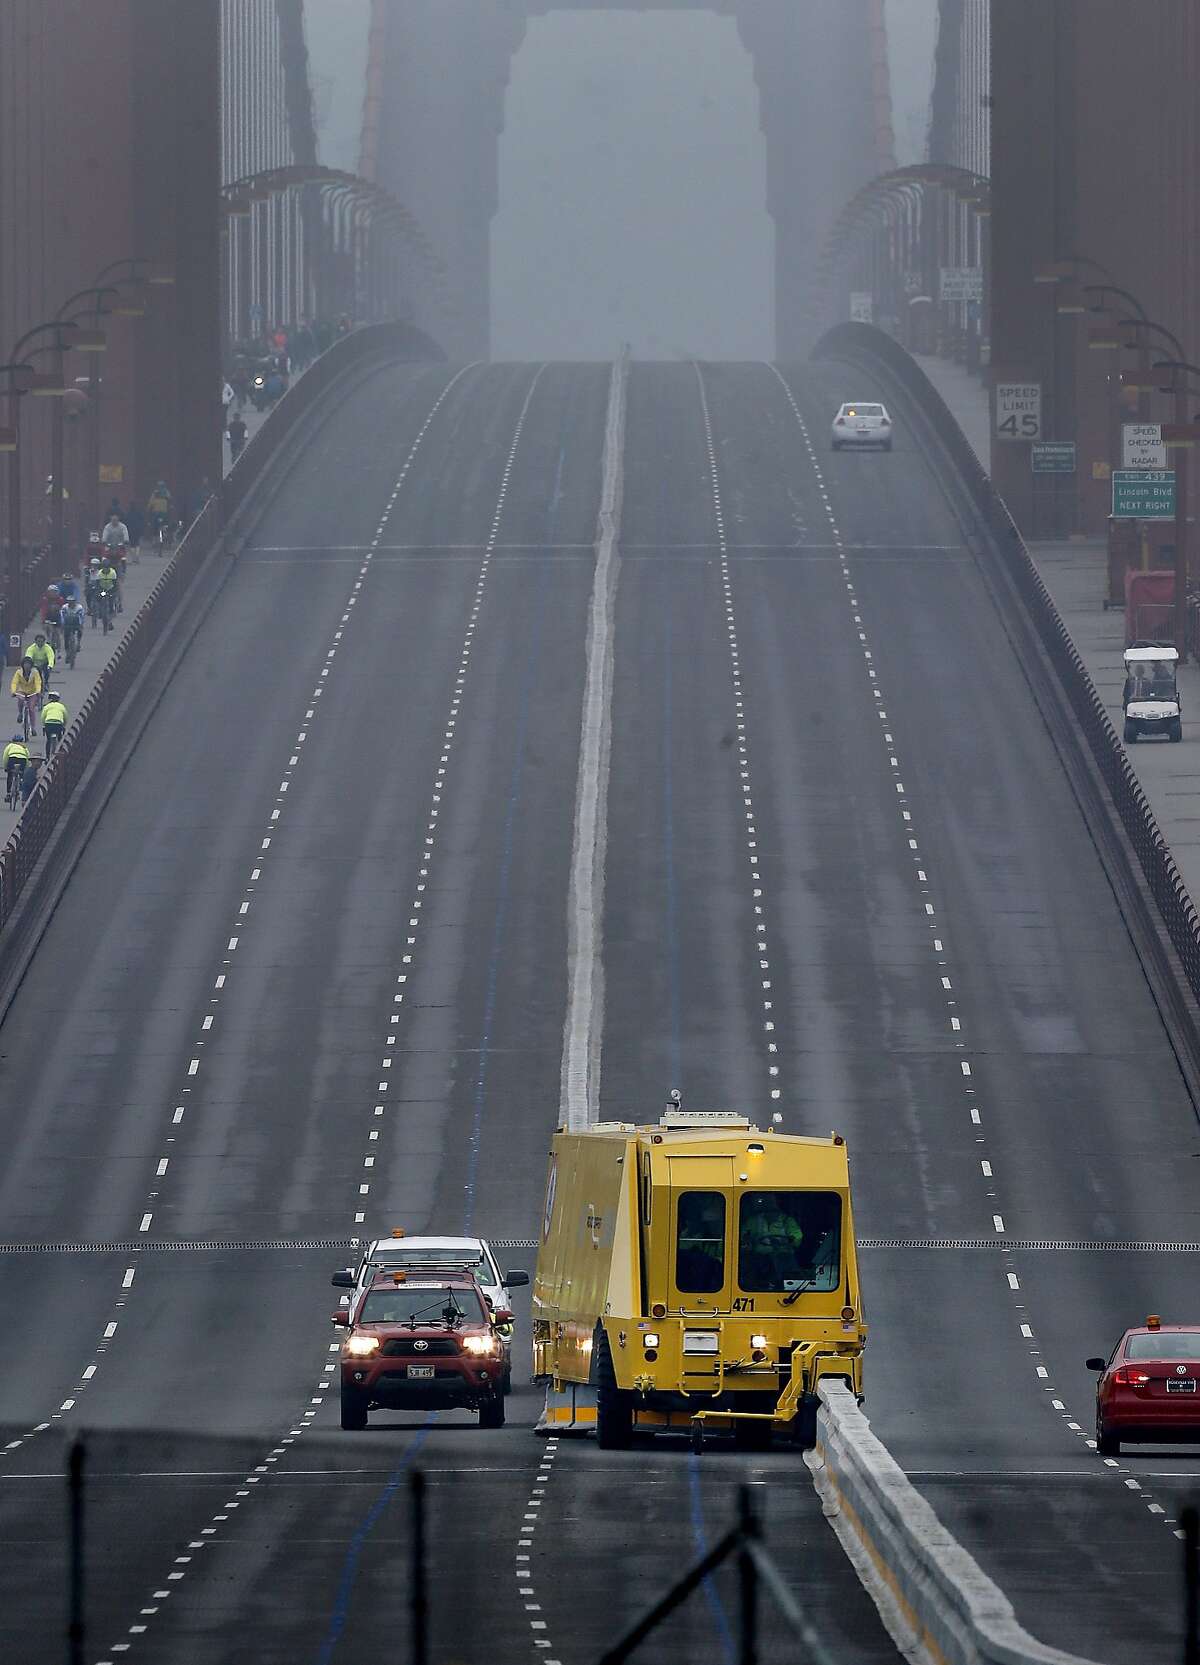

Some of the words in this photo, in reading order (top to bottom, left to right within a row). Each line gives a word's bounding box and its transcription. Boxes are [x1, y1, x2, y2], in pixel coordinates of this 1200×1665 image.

[999, 388, 1038, 397] SPEED
[1003, 401, 1036, 411] LIMIT
[998, 414, 1039, 436] 45
[1118, 487, 1149, 496] Lincoln
[1153, 487, 1172, 496] Blvd
[1119, 501, 1141, 510] NEXT
[1145, 501, 1171, 510] RIGHT
[733, 1297, 755, 1312] 471
